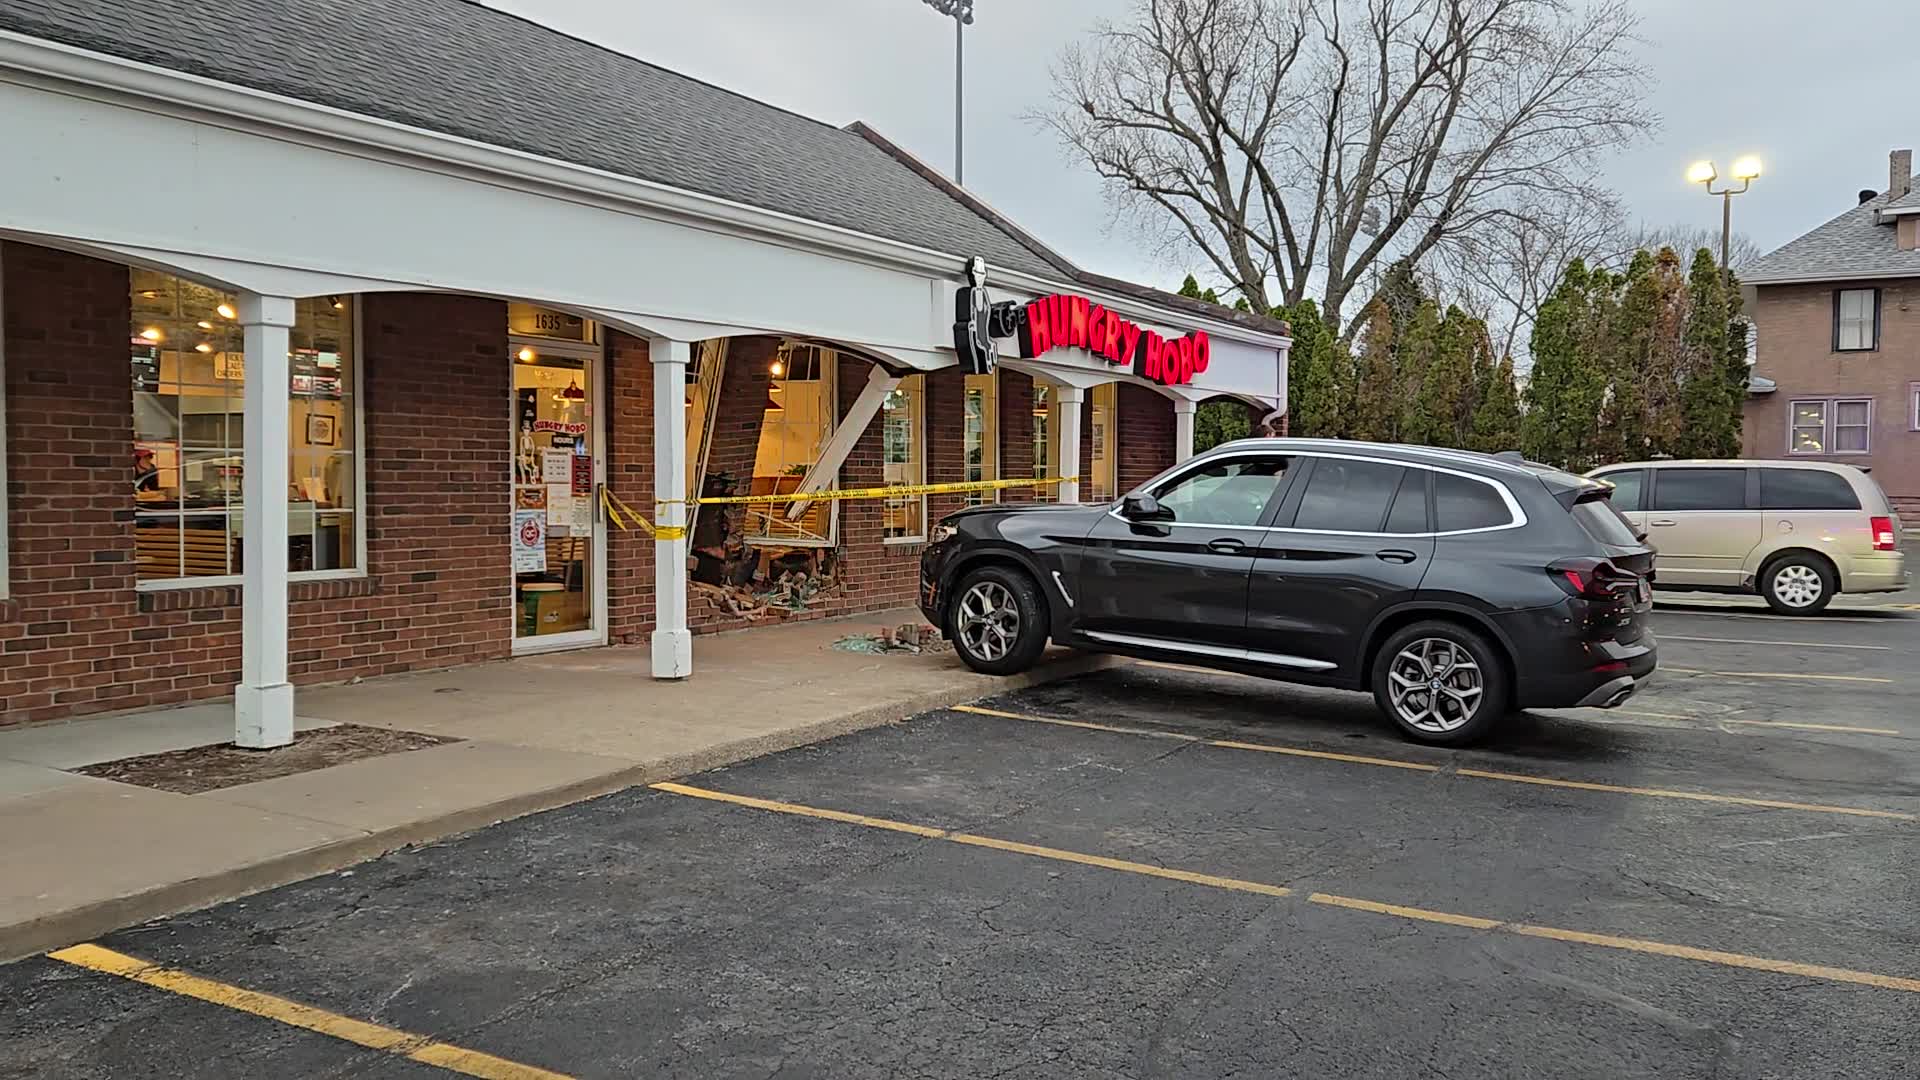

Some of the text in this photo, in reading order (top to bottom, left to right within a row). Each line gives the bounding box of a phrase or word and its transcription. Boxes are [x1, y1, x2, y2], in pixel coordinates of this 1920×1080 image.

[535, 313, 560, 330] 1635
[1026, 293, 1141, 366] HUNGRY
[1146, 329, 1210, 385] HOBO
[535, 420, 586, 433] HUNGRY HOBO
